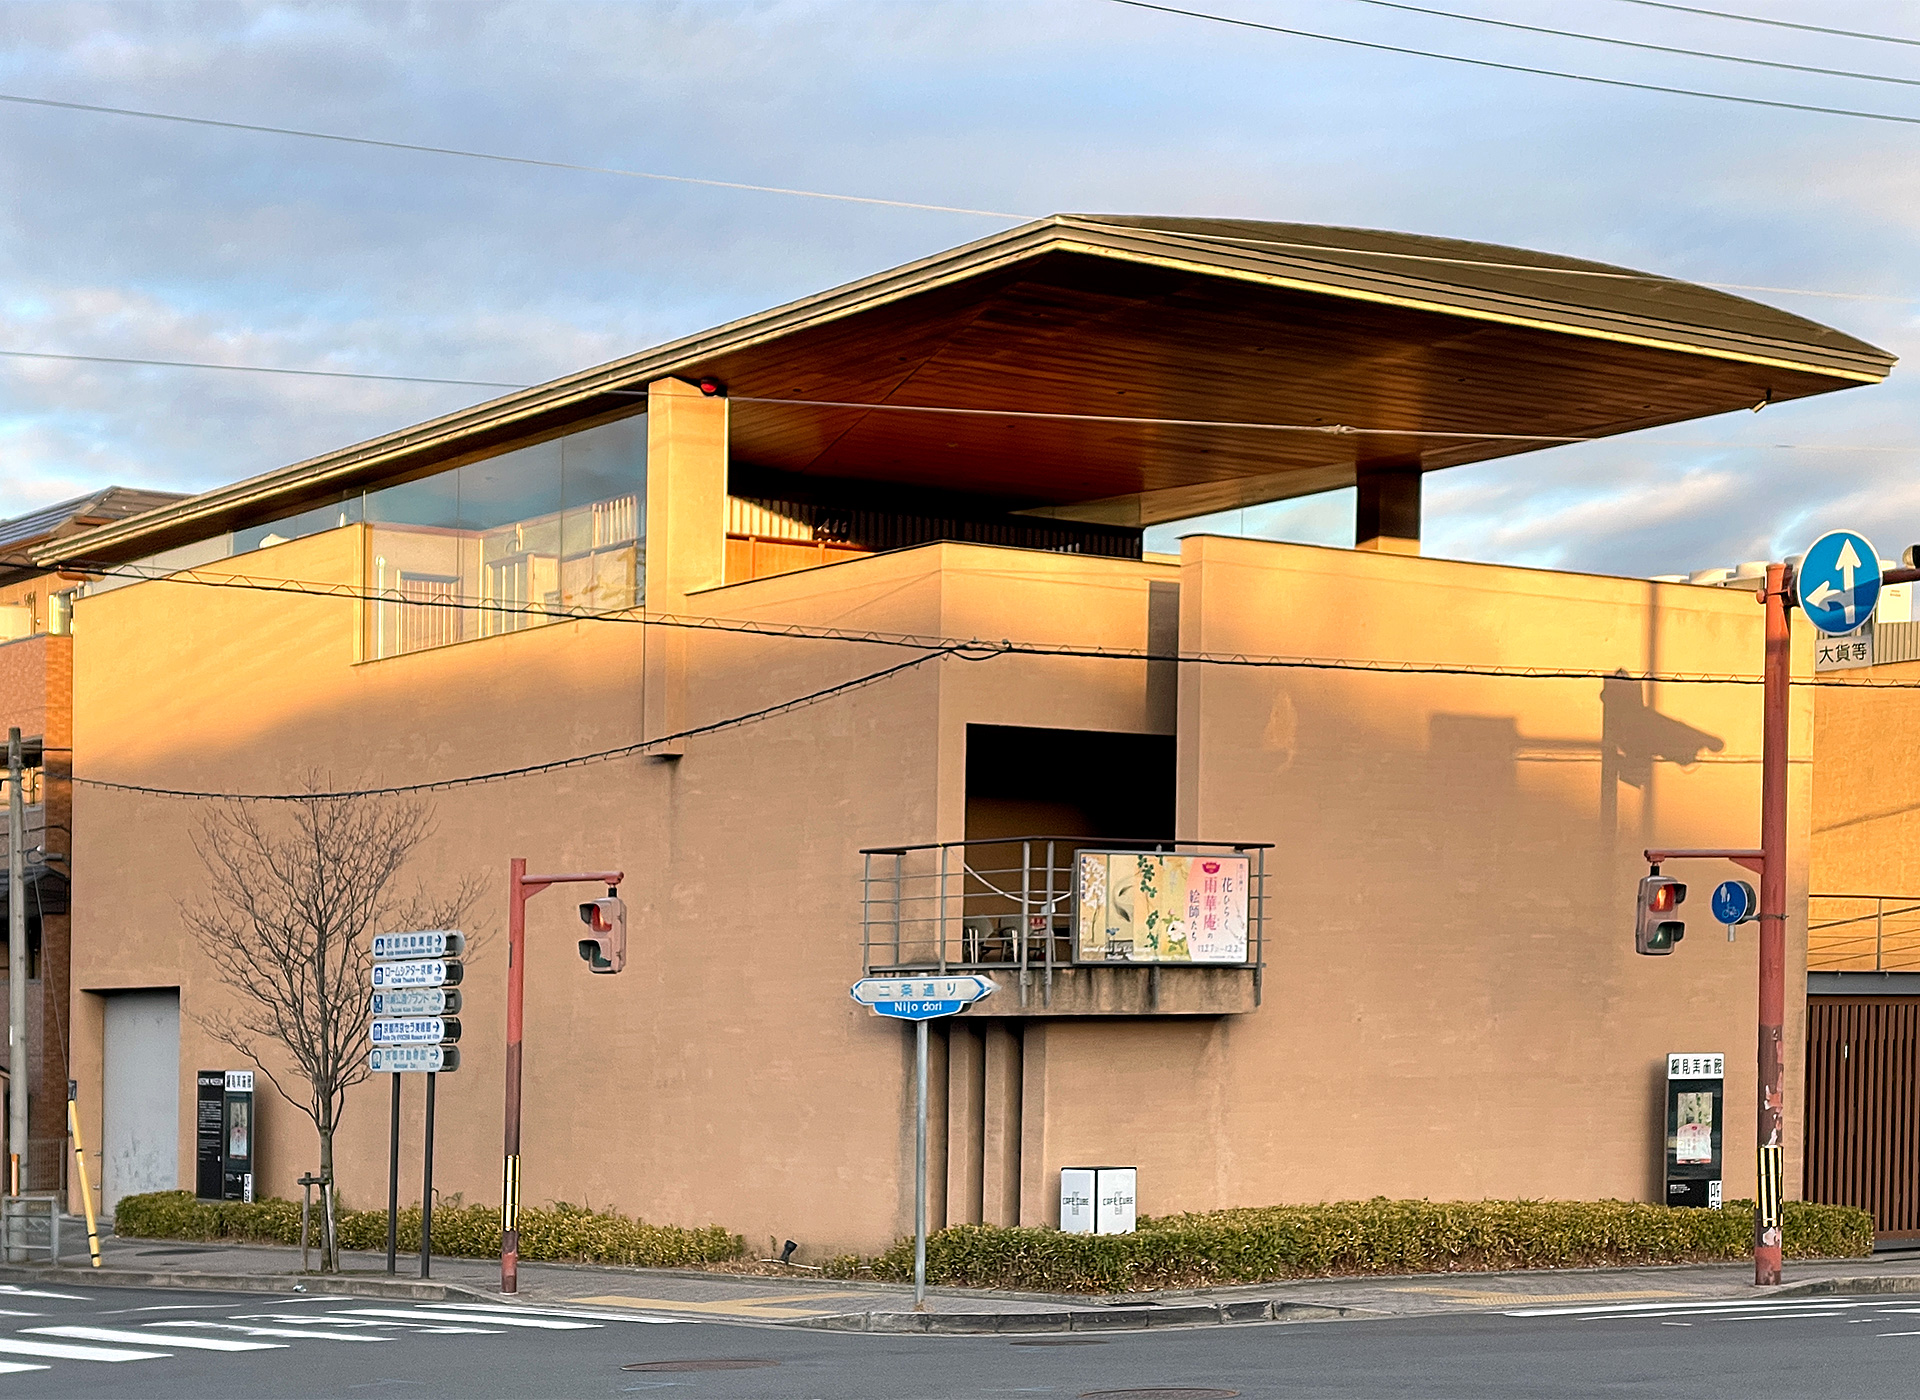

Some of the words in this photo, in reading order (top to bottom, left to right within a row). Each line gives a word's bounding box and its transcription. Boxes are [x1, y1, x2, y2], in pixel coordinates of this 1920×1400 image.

[1819, 642, 1867, 664] 大貨等
[1222, 877, 1232, 930] 花ひらく
[1189, 889, 1200, 941] 絵師たち
[878, 982, 957, 997] 二条通り
[894, 1002, 918, 1014] Nijo
[922, 1001, 942, 1011] dori
